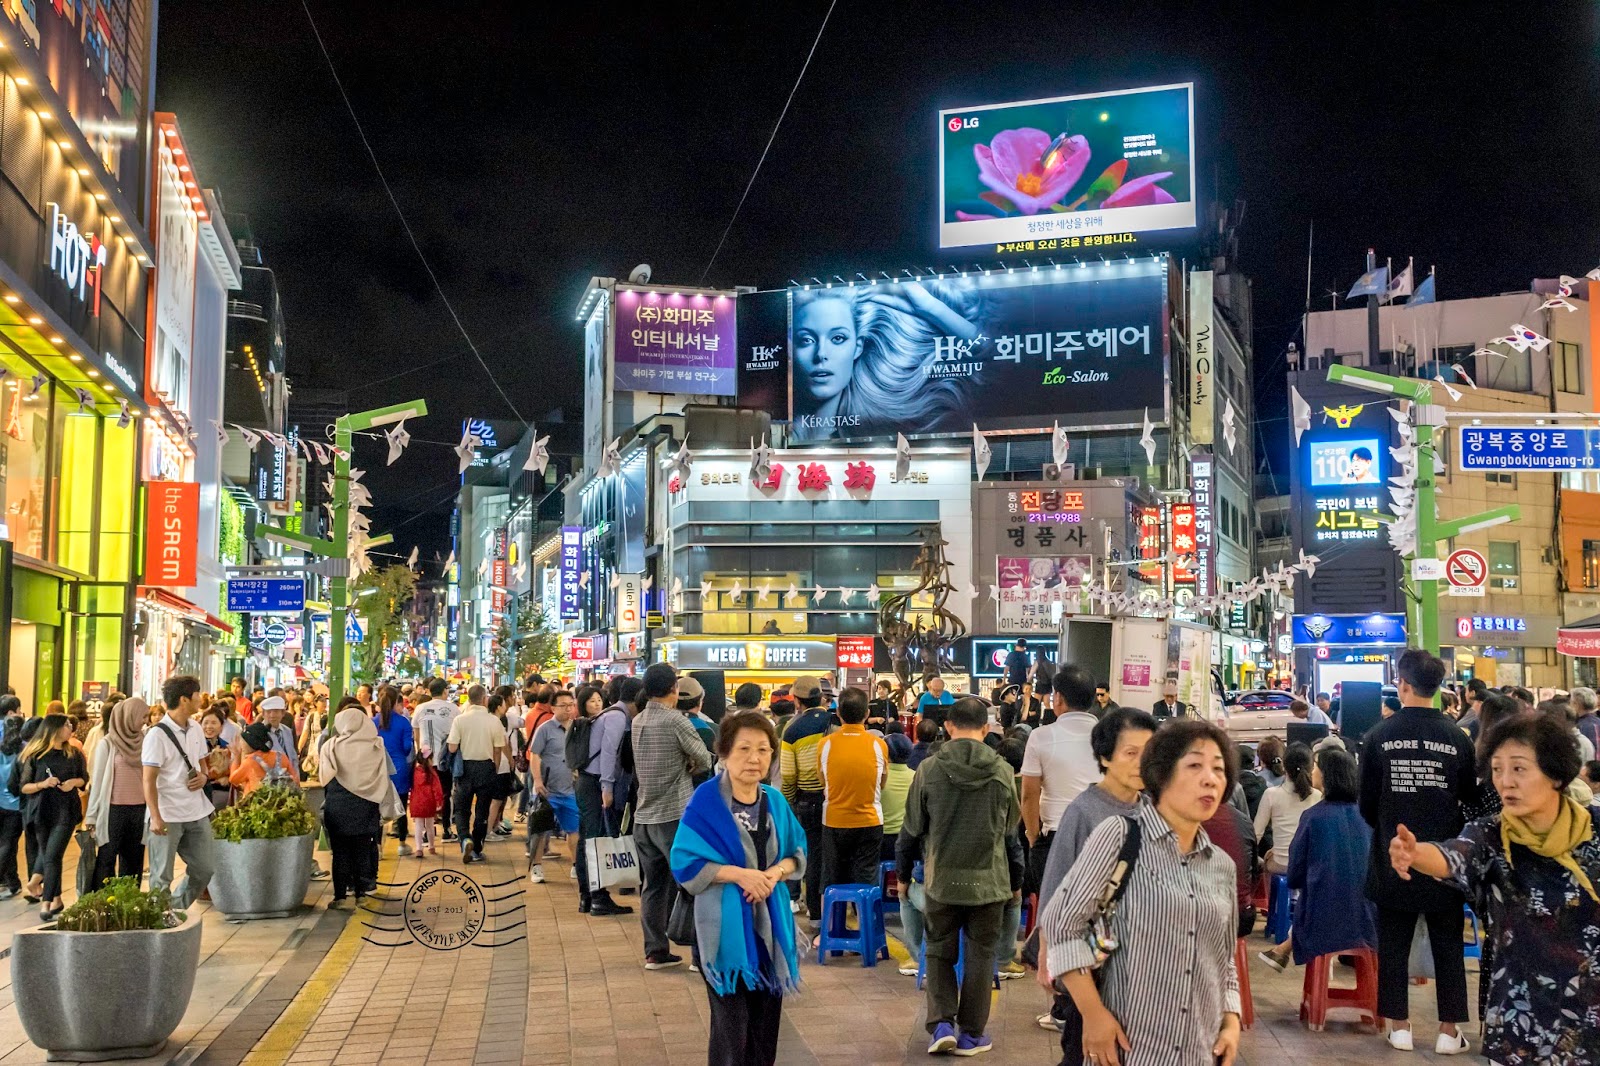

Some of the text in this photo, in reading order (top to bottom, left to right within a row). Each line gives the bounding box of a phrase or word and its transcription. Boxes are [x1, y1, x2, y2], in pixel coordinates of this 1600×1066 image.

[963, 117, 979, 128] LG
[1027, 216, 1103, 233] 청정한 세상을 위해
[1006, 241, 1034, 253] 부산에
[1038, 239, 1057, 250] 오신
[1061, 237, 1080, 248] 것을
[636, 306, 715, 327] (주)화미주
[631, 329, 719, 351] 인터내셔날
[993, 325, 1150, 363] 화미주헤어
[746, 361, 779, 370] HWAMIJU
[922, 362, 983, 376] HWAMIJU
[1194, 325, 1210, 405] Nail County
[632, 368, 717, 381] 화미주 기업 부설 연구소
[1042, 369, 1109, 385] Eco-Salon
[801, 415, 861, 428] KÉRASTASE
[1466, 432, 1568, 452] 광복중앙로
[1467, 454, 1595, 468] Gwangbokjungang-ro
[165, 487, 182, 513] the
[1021, 490, 1084, 512] 전당포
[1316, 498, 1350, 510] 국민이
[1028, 513, 1080, 523] 231-9988
[1195, 480, 1212, 546] 화미주헤어
[564, 547, 578, 606] 화미주헤어
[231, 581, 268, 589] 국제시장2길
[1473, 617, 1526, 631] 관광안내소
[573, 641, 592, 649] SALE
[576, 649, 588, 658] 50
[707, 648, 747, 662] MEGA
[765, 648, 806, 662] COFFEE
[1423, 741, 1457, 756] TIMES
[612, 851, 636, 869] NBA
